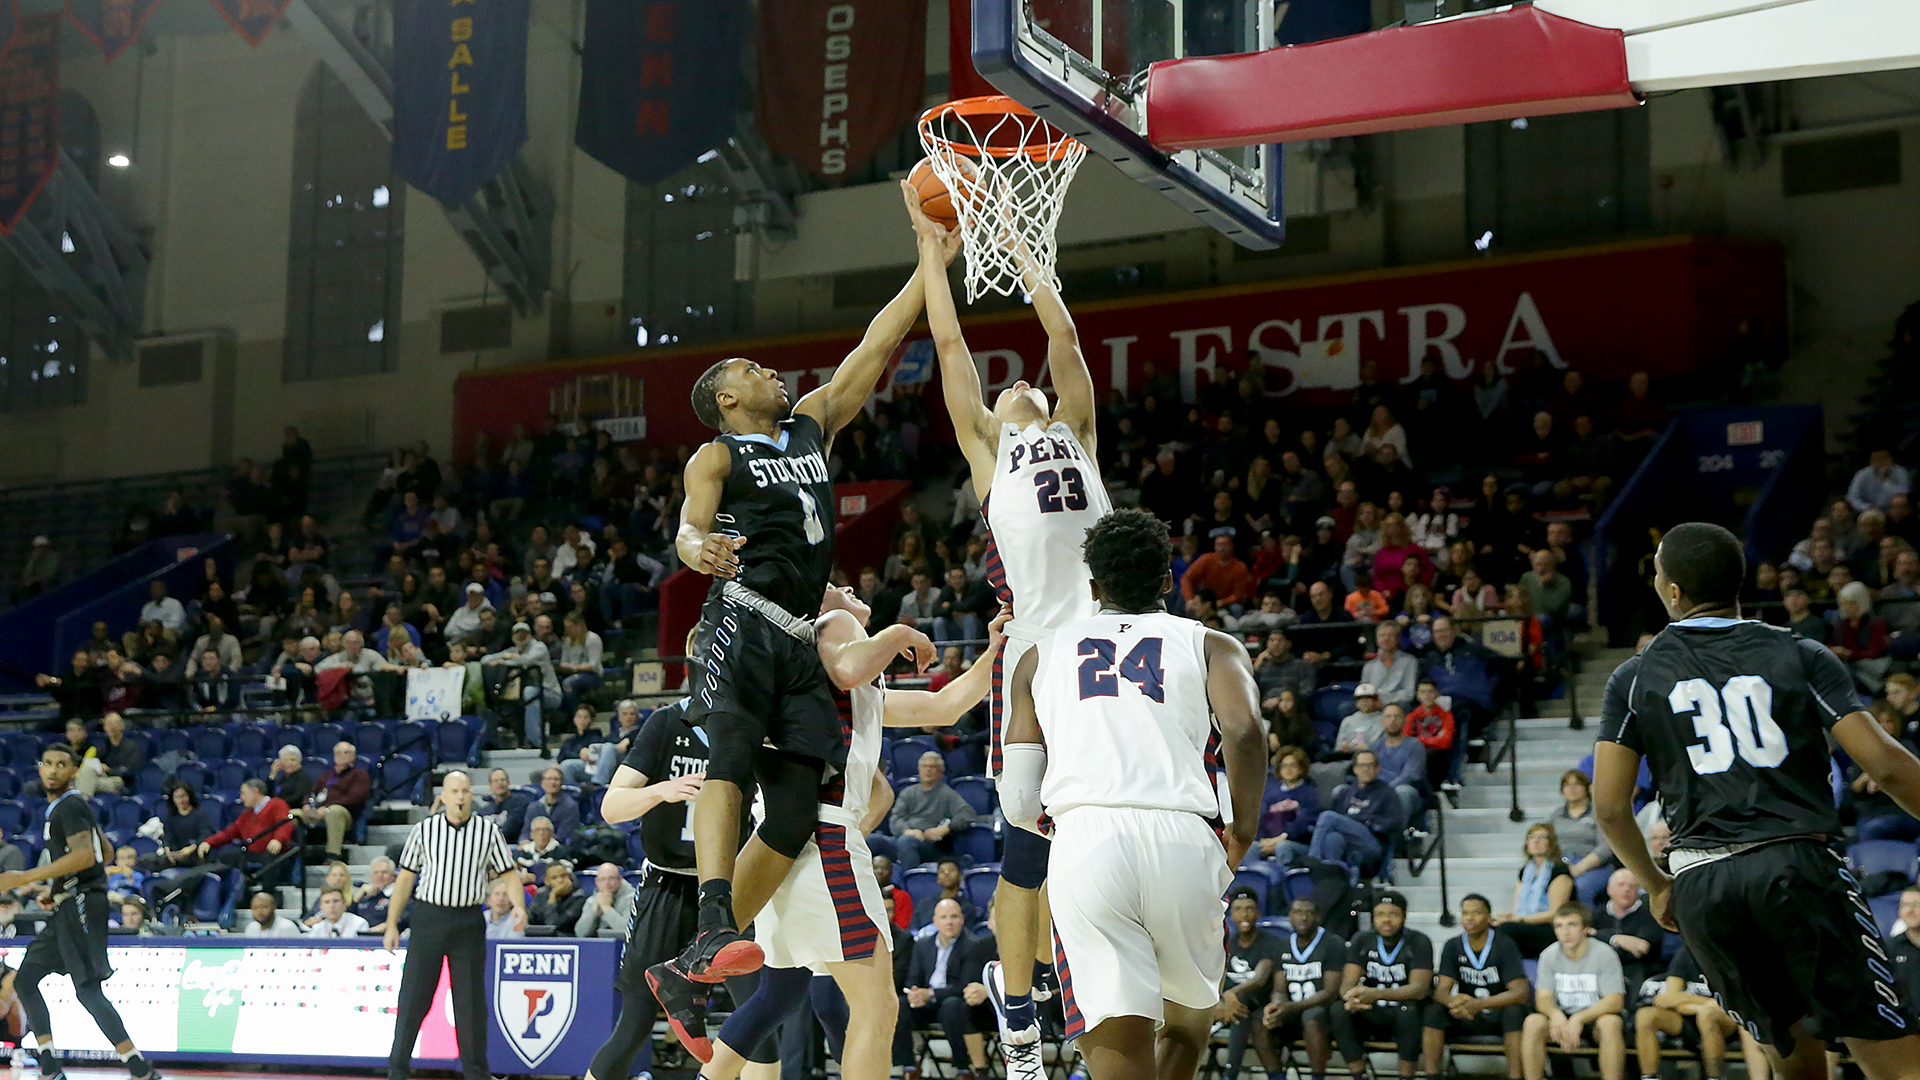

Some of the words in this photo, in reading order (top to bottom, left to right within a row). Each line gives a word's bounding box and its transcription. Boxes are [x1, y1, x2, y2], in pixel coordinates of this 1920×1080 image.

[447, 17, 474, 150] SALLE
[637, 4, 676, 136] ENN
[820, 3, 855, 174] OSEPHS
[1034, 467, 1089, 513] 23
[1078, 637, 1165, 703] 24
[1668, 675, 1790, 776] 30
[503, 953, 572, 976] PENN
[521, 989, 555, 1039] P
